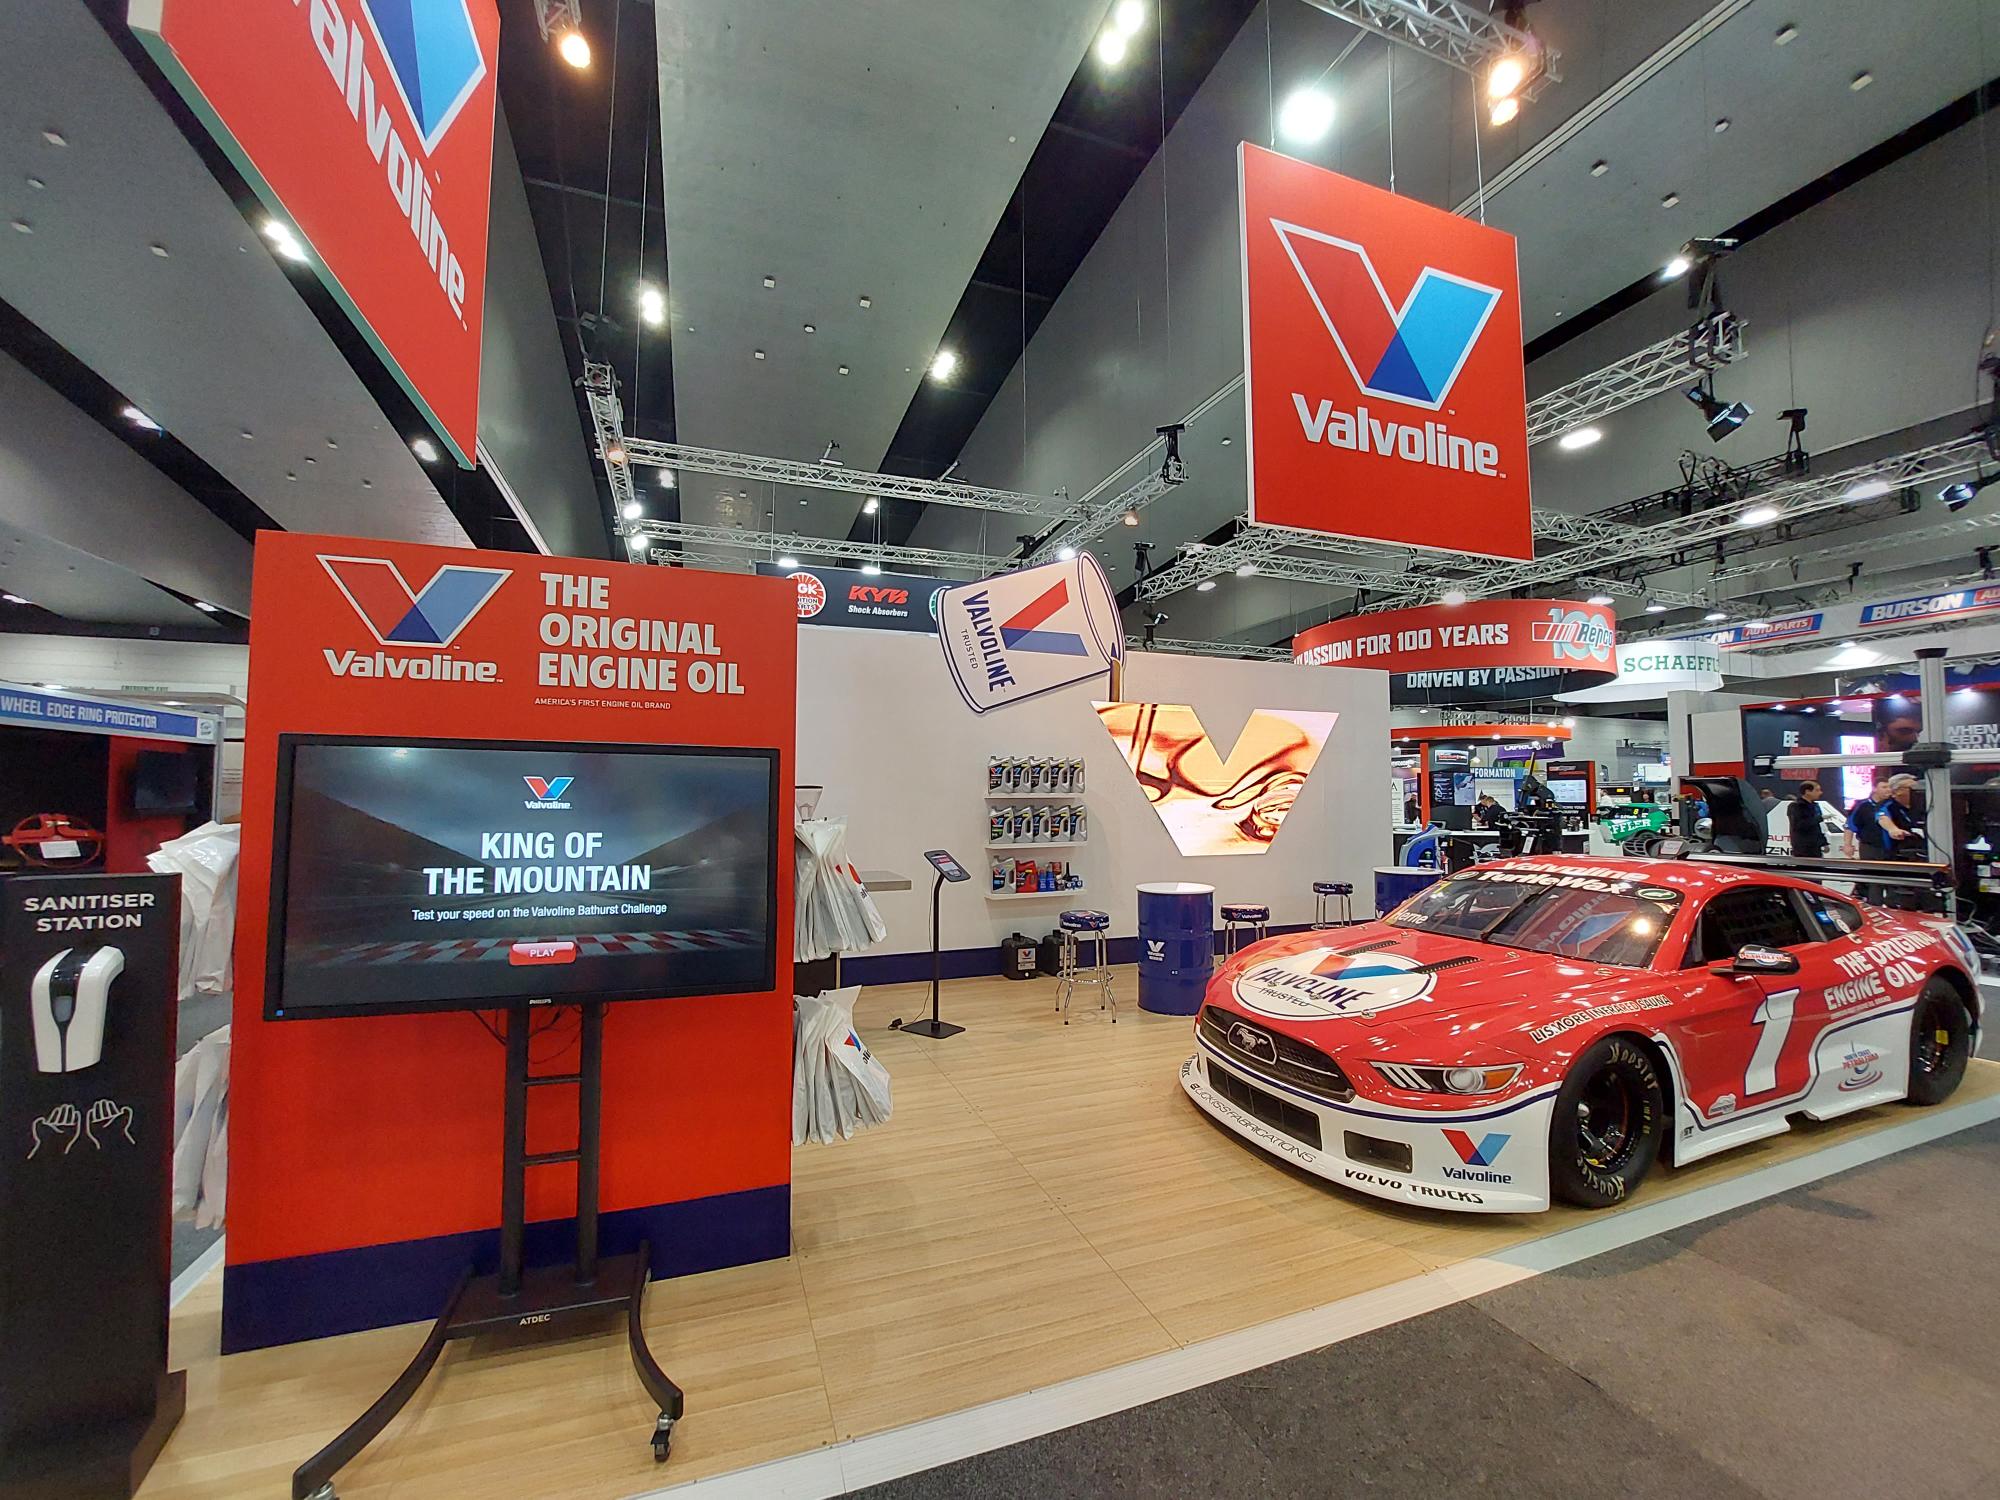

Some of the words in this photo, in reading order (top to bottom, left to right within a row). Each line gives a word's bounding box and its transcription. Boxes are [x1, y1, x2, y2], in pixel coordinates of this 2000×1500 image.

[293, 0, 467, 322] alvoline
[1290, 393, 1499, 478] Valvoline
[540, 572, 610, 609] THE
[796, 583, 818, 595] GK
[848, 585, 909, 605] KYB
[847, 604, 872, 615] Shock
[873, 607, 909, 618] Absorbers
[1870, 592, 1965, 621] BURSON
[540, 613, 721, 656] ORIGINAL
[960, 628, 979, 670] TRUSTED
[962, 590, 1016, 693] VALVOLINE
[1303, 639, 1353, 666] PASSION
[1356, 633, 1392, 657] FOR
[1396, 628, 1432, 652] 100
[1437, 623, 1508, 648] YEARS
[1576, 621, 1614, 649] Repco
[322, 649, 499, 682] Valvoline
[538, 653, 677, 692] ENGINE
[687, 661, 745, 695] OIL
[1406, 670, 1464, 690] DRIVEN
[1468, 669, 1491, 687] BY
[0, 695, 43, 715] WHEEL
[46, 702, 76, 719] EDGE
[78, 706, 102, 723] RING
[105, 711, 157, 728] PROTECTOR
[535, 698, 576, 706] AMERICA'S
[578, 699, 600, 707] FIRST
[601, 700, 630, 708] ENGINE
[631, 701, 643, 709] OIL
[645, 702, 671, 710] BRAND
[1783, 731, 1799, 747] BE
[524, 801, 573, 810] Valvoline
[481, 832, 556, 860] KING
[564, 831, 603, 858] OF
[423, 867, 485, 896] THE
[494, 864, 651, 894] MOUNTAIN
[1496, 861, 1650, 882] Valvoline
[24, 893, 155, 913] SANITISER
[412, 909, 435, 921] Test
[437, 910, 461, 922] your
[463, 908, 495, 920] speed
[497, 908, 511, 918] on
[513, 906, 530, 918] the
[532, 905, 576, 917] Valvoline
[577, 904, 619, 916] Bathurst
[621, 902, 668, 915] Challenge
[36, 913, 142, 932] STATION
[529, 948, 557, 959] PLAY
[1864, 930, 1937, 966] ORIGINAL
[1833, 949, 1875, 978] THE
[1260, 987, 1309, 1007] TRUSTED
[1823, 971, 1885, 1011] ENGINE
[1883, 960, 1926, 989] OIL
[1531, 1011, 1589, 1043] LISMORE
[1588, 1000, 1641, 1020] INFRARED
[1638, 994, 1671, 1010] SAUNA
[1744, 987, 1800, 1097] 1
[1344, 1168, 1403, 1190] VOLVO
[1410, 1183, 1484, 1204] TRUCKS
[1442, 1166, 1512, 1184] Valvoline
[520, 1313, 550, 1326] ATDEC
